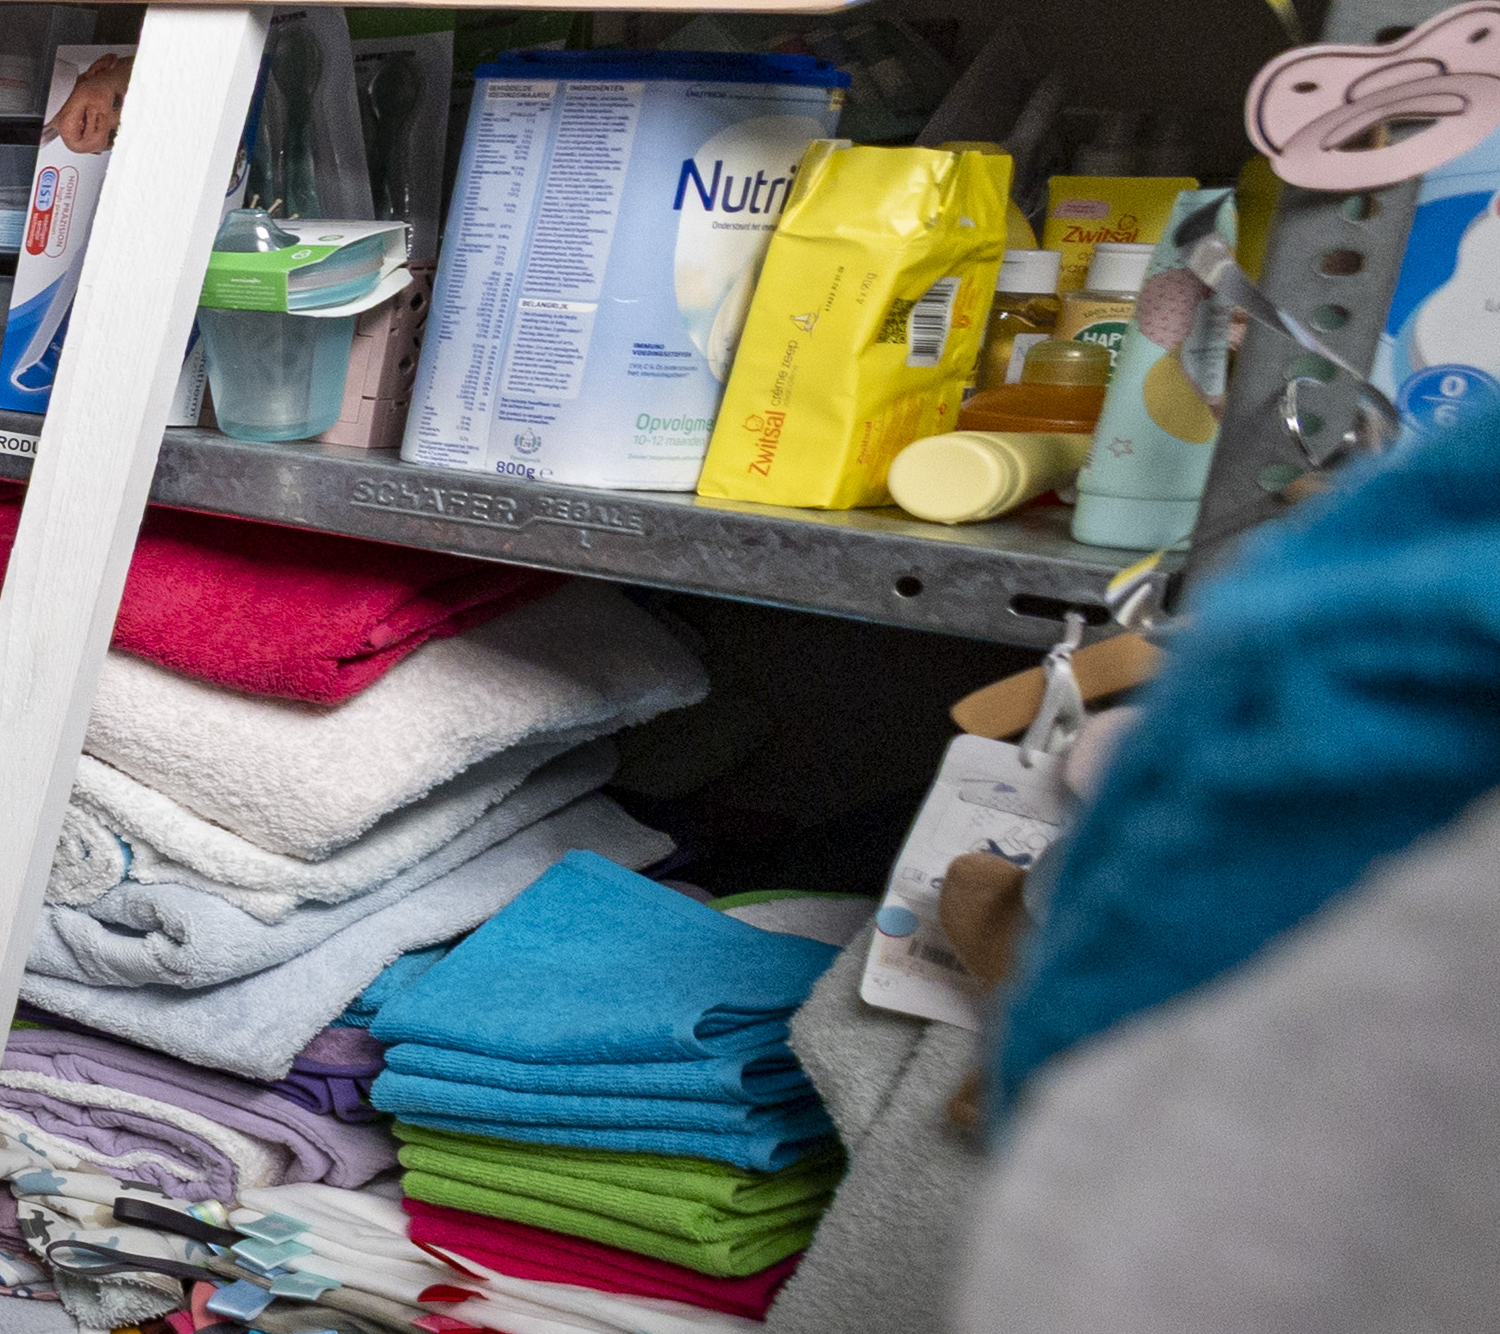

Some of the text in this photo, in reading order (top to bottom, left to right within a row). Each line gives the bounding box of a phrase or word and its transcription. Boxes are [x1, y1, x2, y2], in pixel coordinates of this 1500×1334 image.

[39, 184, 52, 207] IST
[56, 175, 76, 249] HOHE PRÄZISION
[521, 299, 569, 310] BELANGRIJK
[771, 339, 799, 408] crème zeep
[633, 435, 706, 447] 10-12 maanden
[747, 409, 787, 478] Zwitsal
[496, 460, 535, 480] 800g
[537, 495, 644, 530] REGALE
